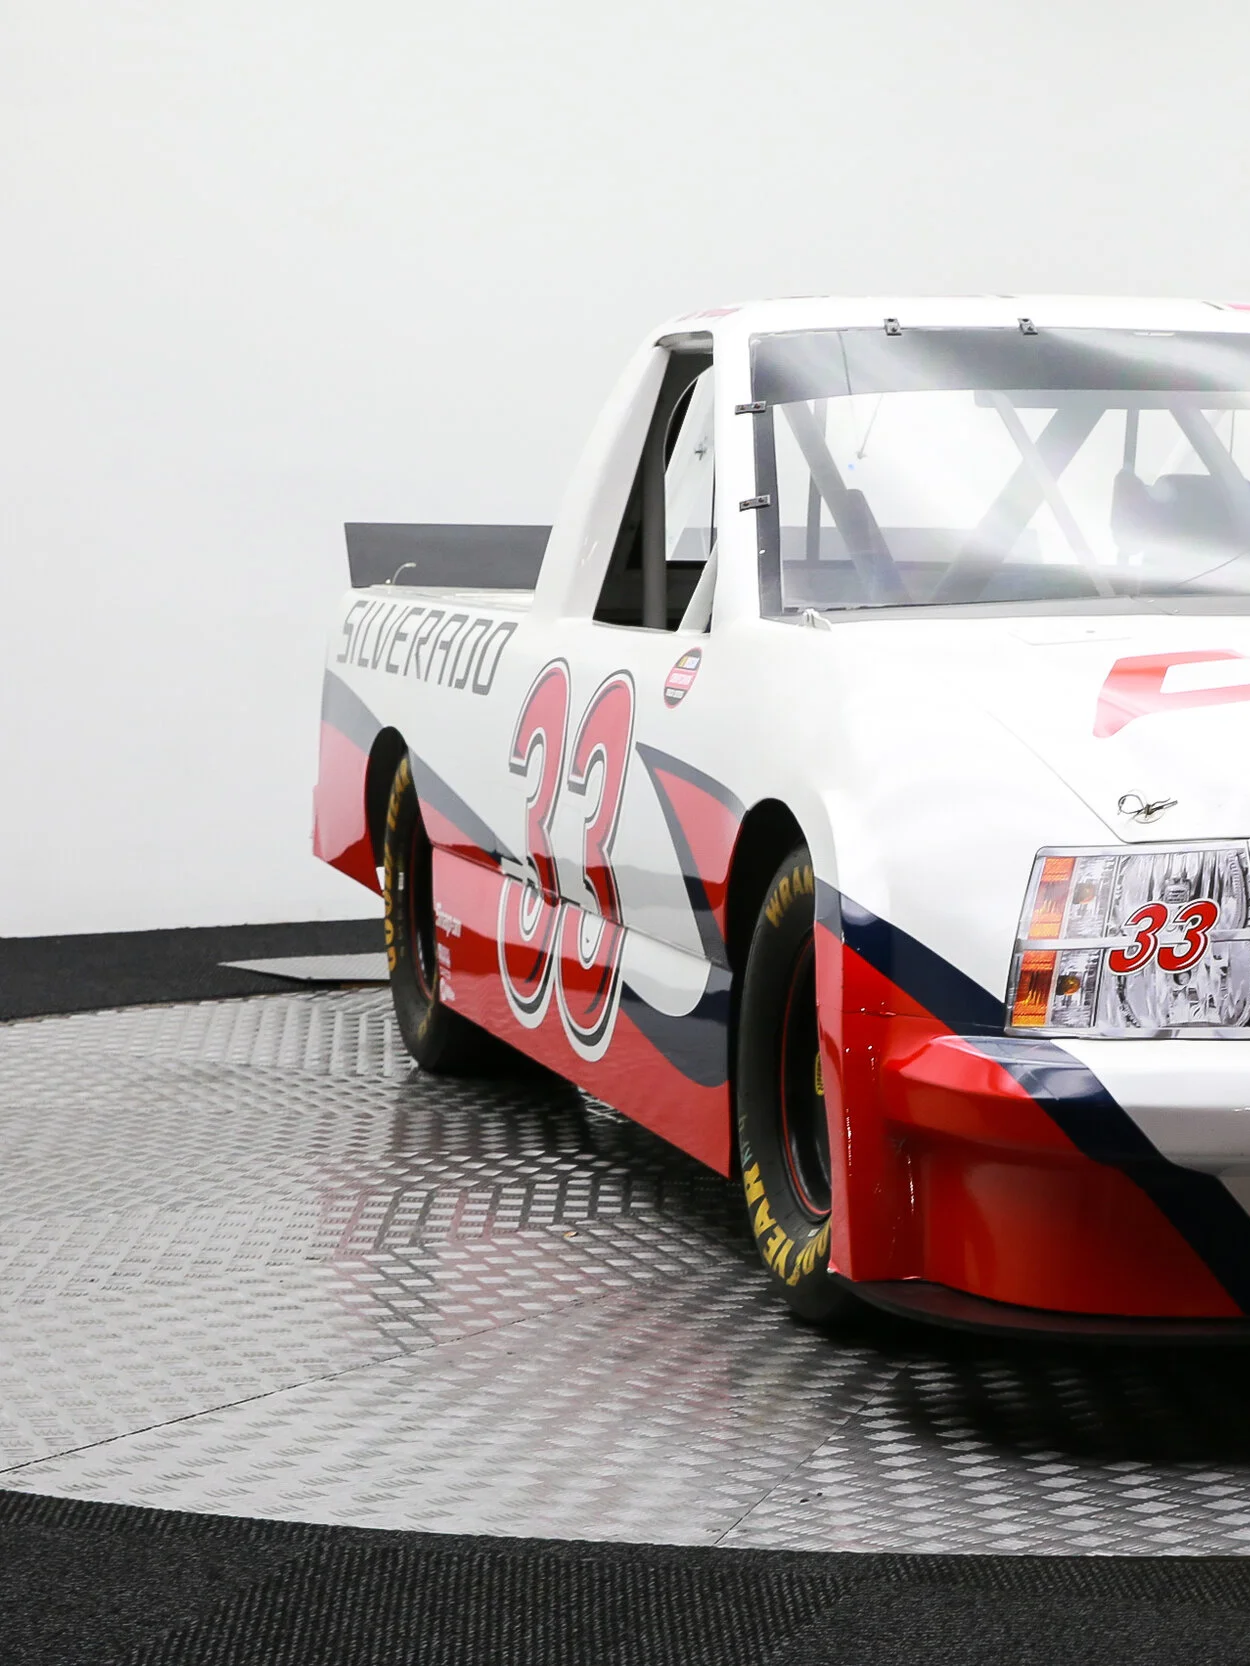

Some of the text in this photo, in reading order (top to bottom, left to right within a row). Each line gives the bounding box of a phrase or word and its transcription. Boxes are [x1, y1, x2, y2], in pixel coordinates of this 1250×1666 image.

[337, 600, 518, 696] SILVERADO
[497, 656, 637, 1063] 33
[1108, 898, 1220, 975] 33
